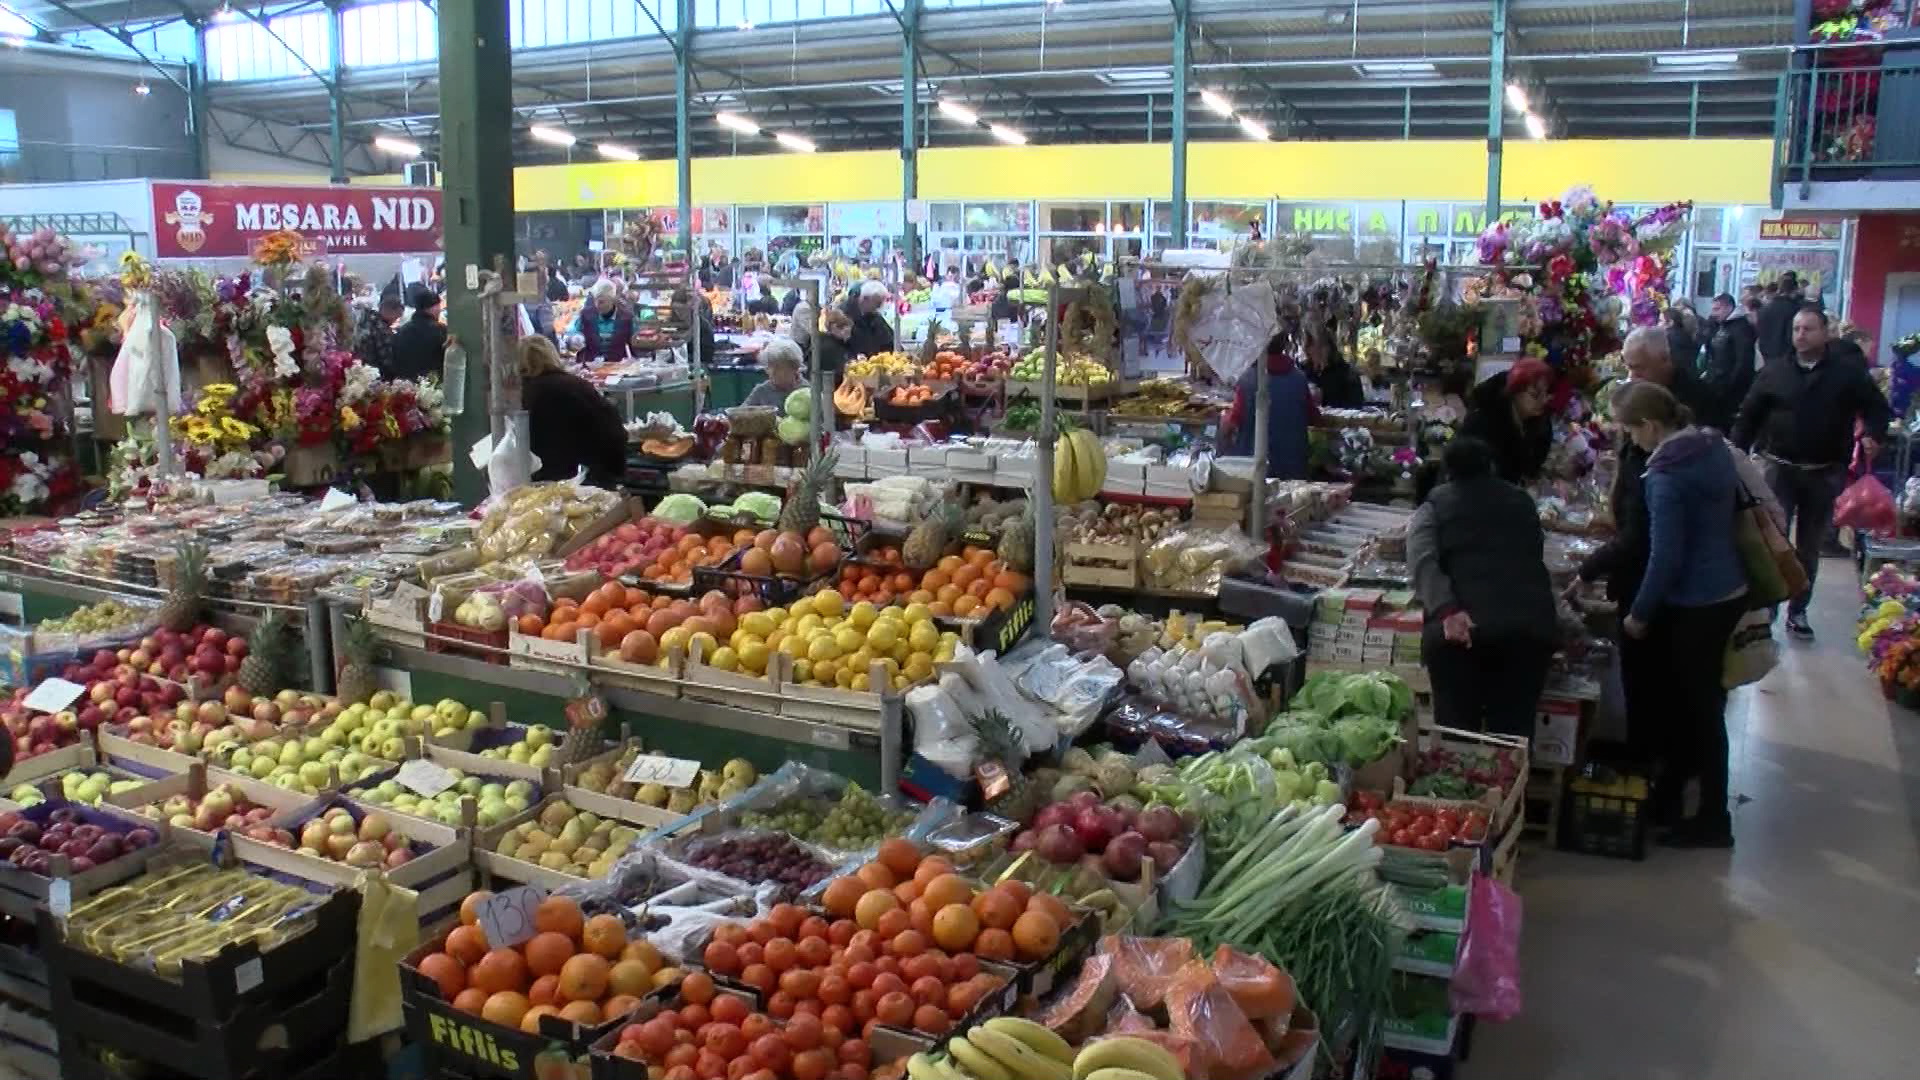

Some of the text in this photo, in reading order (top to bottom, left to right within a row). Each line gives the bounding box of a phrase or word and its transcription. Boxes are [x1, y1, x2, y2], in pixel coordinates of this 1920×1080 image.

[235, 196, 435, 231] MESARA NID
[486, 887, 541, 944] 130
[429, 1013, 520, 1071] Fiflis
